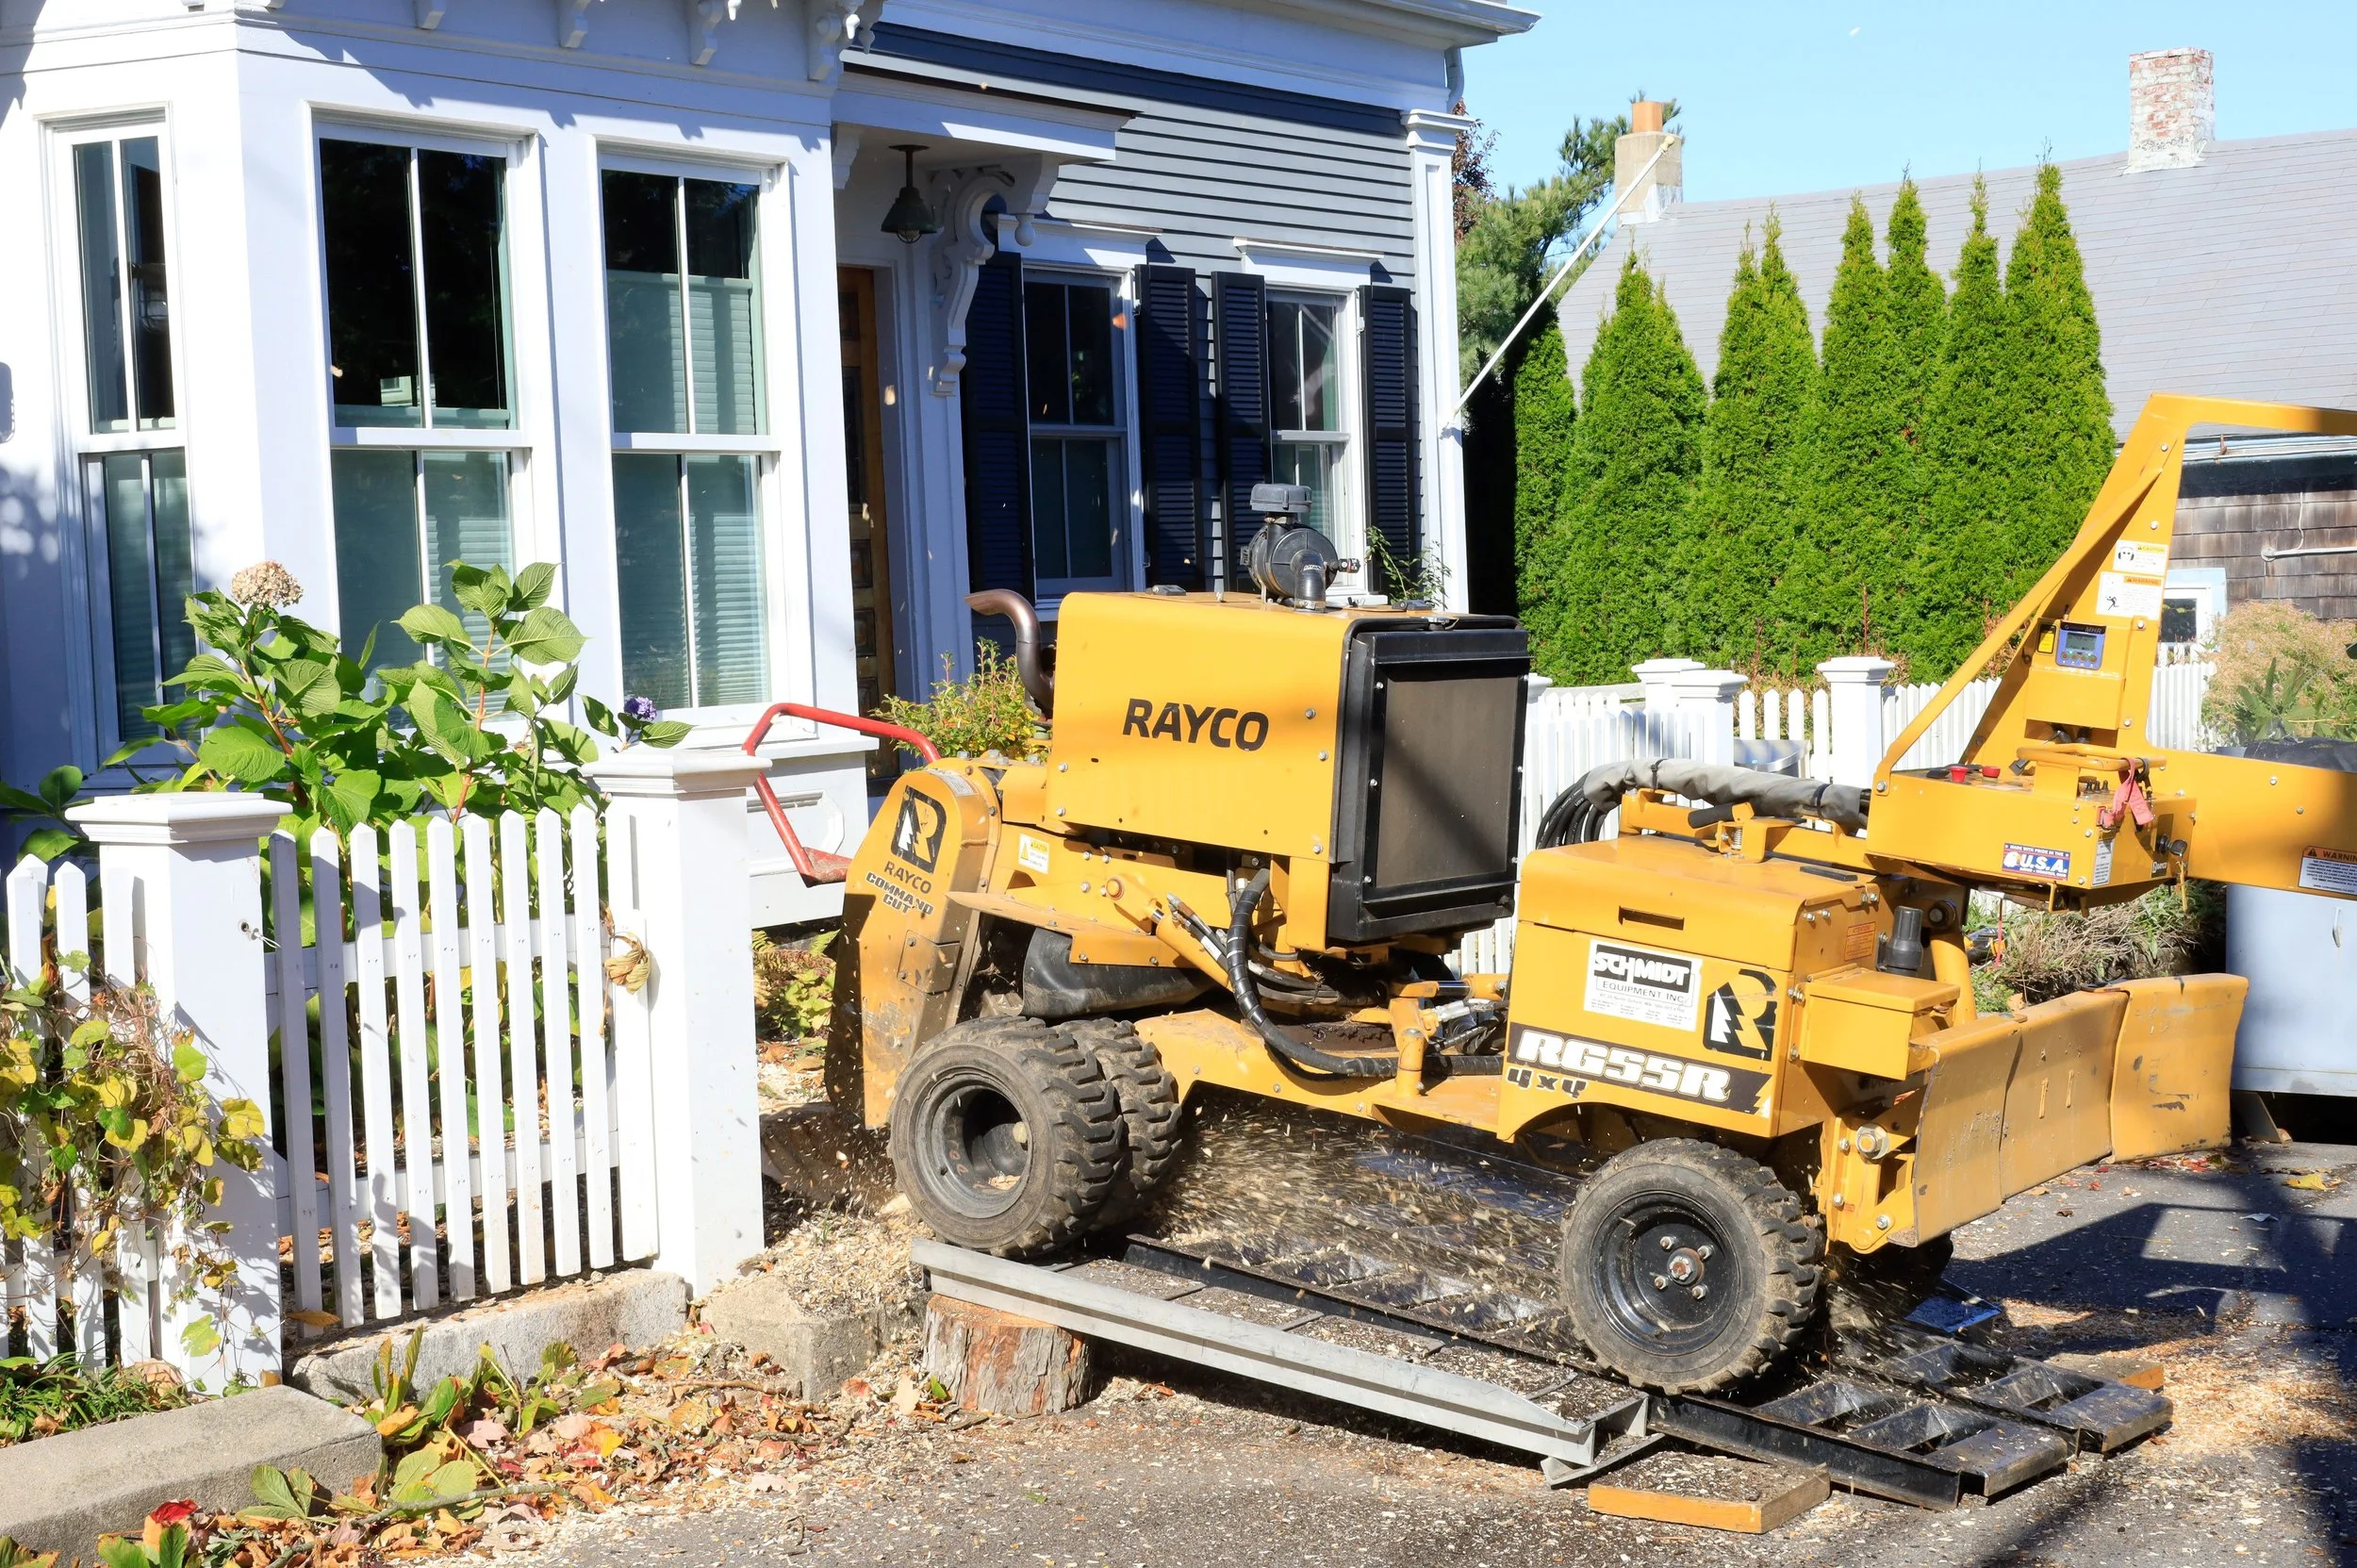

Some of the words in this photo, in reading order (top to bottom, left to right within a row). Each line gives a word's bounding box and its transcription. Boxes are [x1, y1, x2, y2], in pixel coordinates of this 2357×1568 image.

[1122, 698, 1269, 751] RAYCO
[883, 860, 932, 895] RAYCO
[2019, 853, 2068, 873] U.S.A.
[865, 871, 935, 916] COMMAND
[882, 893, 912, 914] CUT
[1594, 951, 1690, 986] SCHMIDT
[1603, 981, 1662, 999] EQUIPMENT
[1506, 1065, 1588, 1099] 4x4
[1515, 1029, 1731, 1102] RG55R
